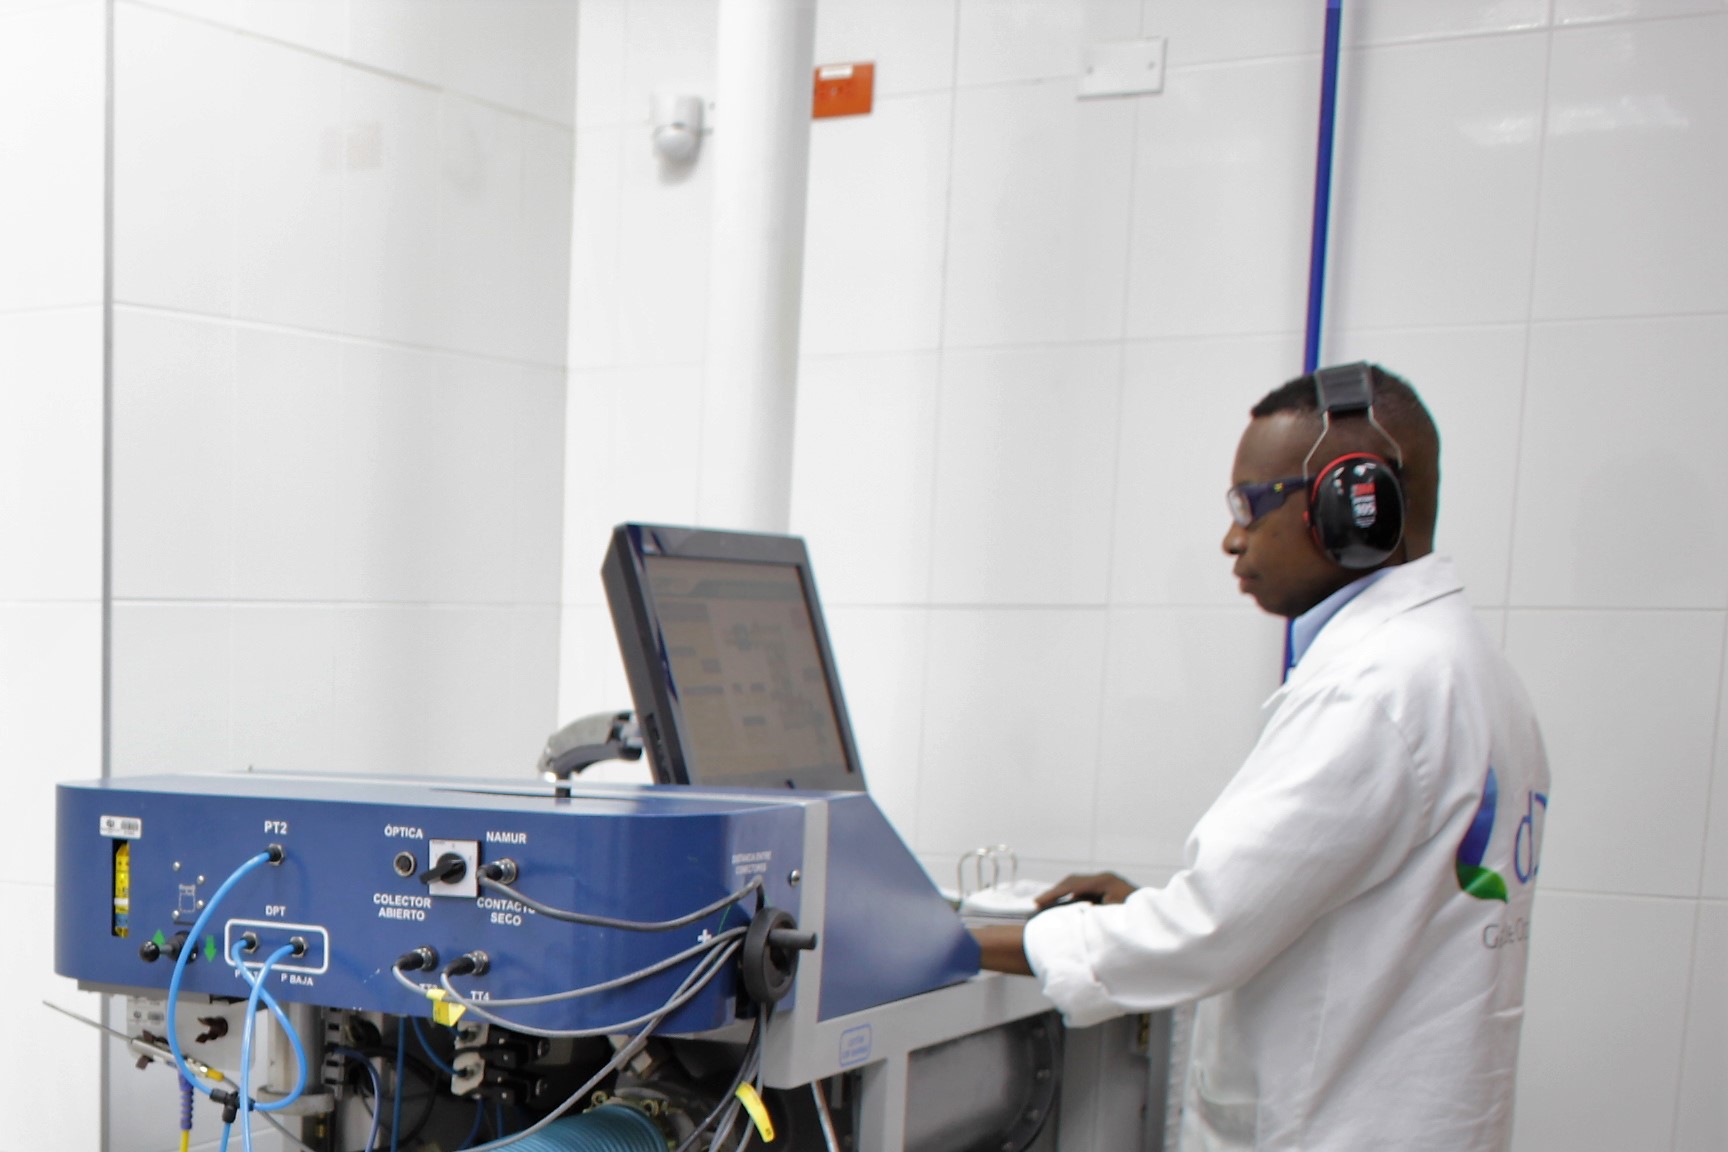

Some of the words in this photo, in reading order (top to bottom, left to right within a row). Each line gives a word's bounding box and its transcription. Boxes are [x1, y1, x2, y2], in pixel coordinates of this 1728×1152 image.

[264, 820, 287, 835] PT2
[384, 824, 424, 839] ÓPTICA
[486, 831, 527, 844] NAMUR
[373, 893, 432, 909] COLECTOR
[265, 904, 286, 917] DPT
[378, 908, 425, 921] ABIERTO
[490, 912, 522, 926] SECO
[289, 974, 314, 986] BAJA
[470, 990, 490, 1001] TT4
